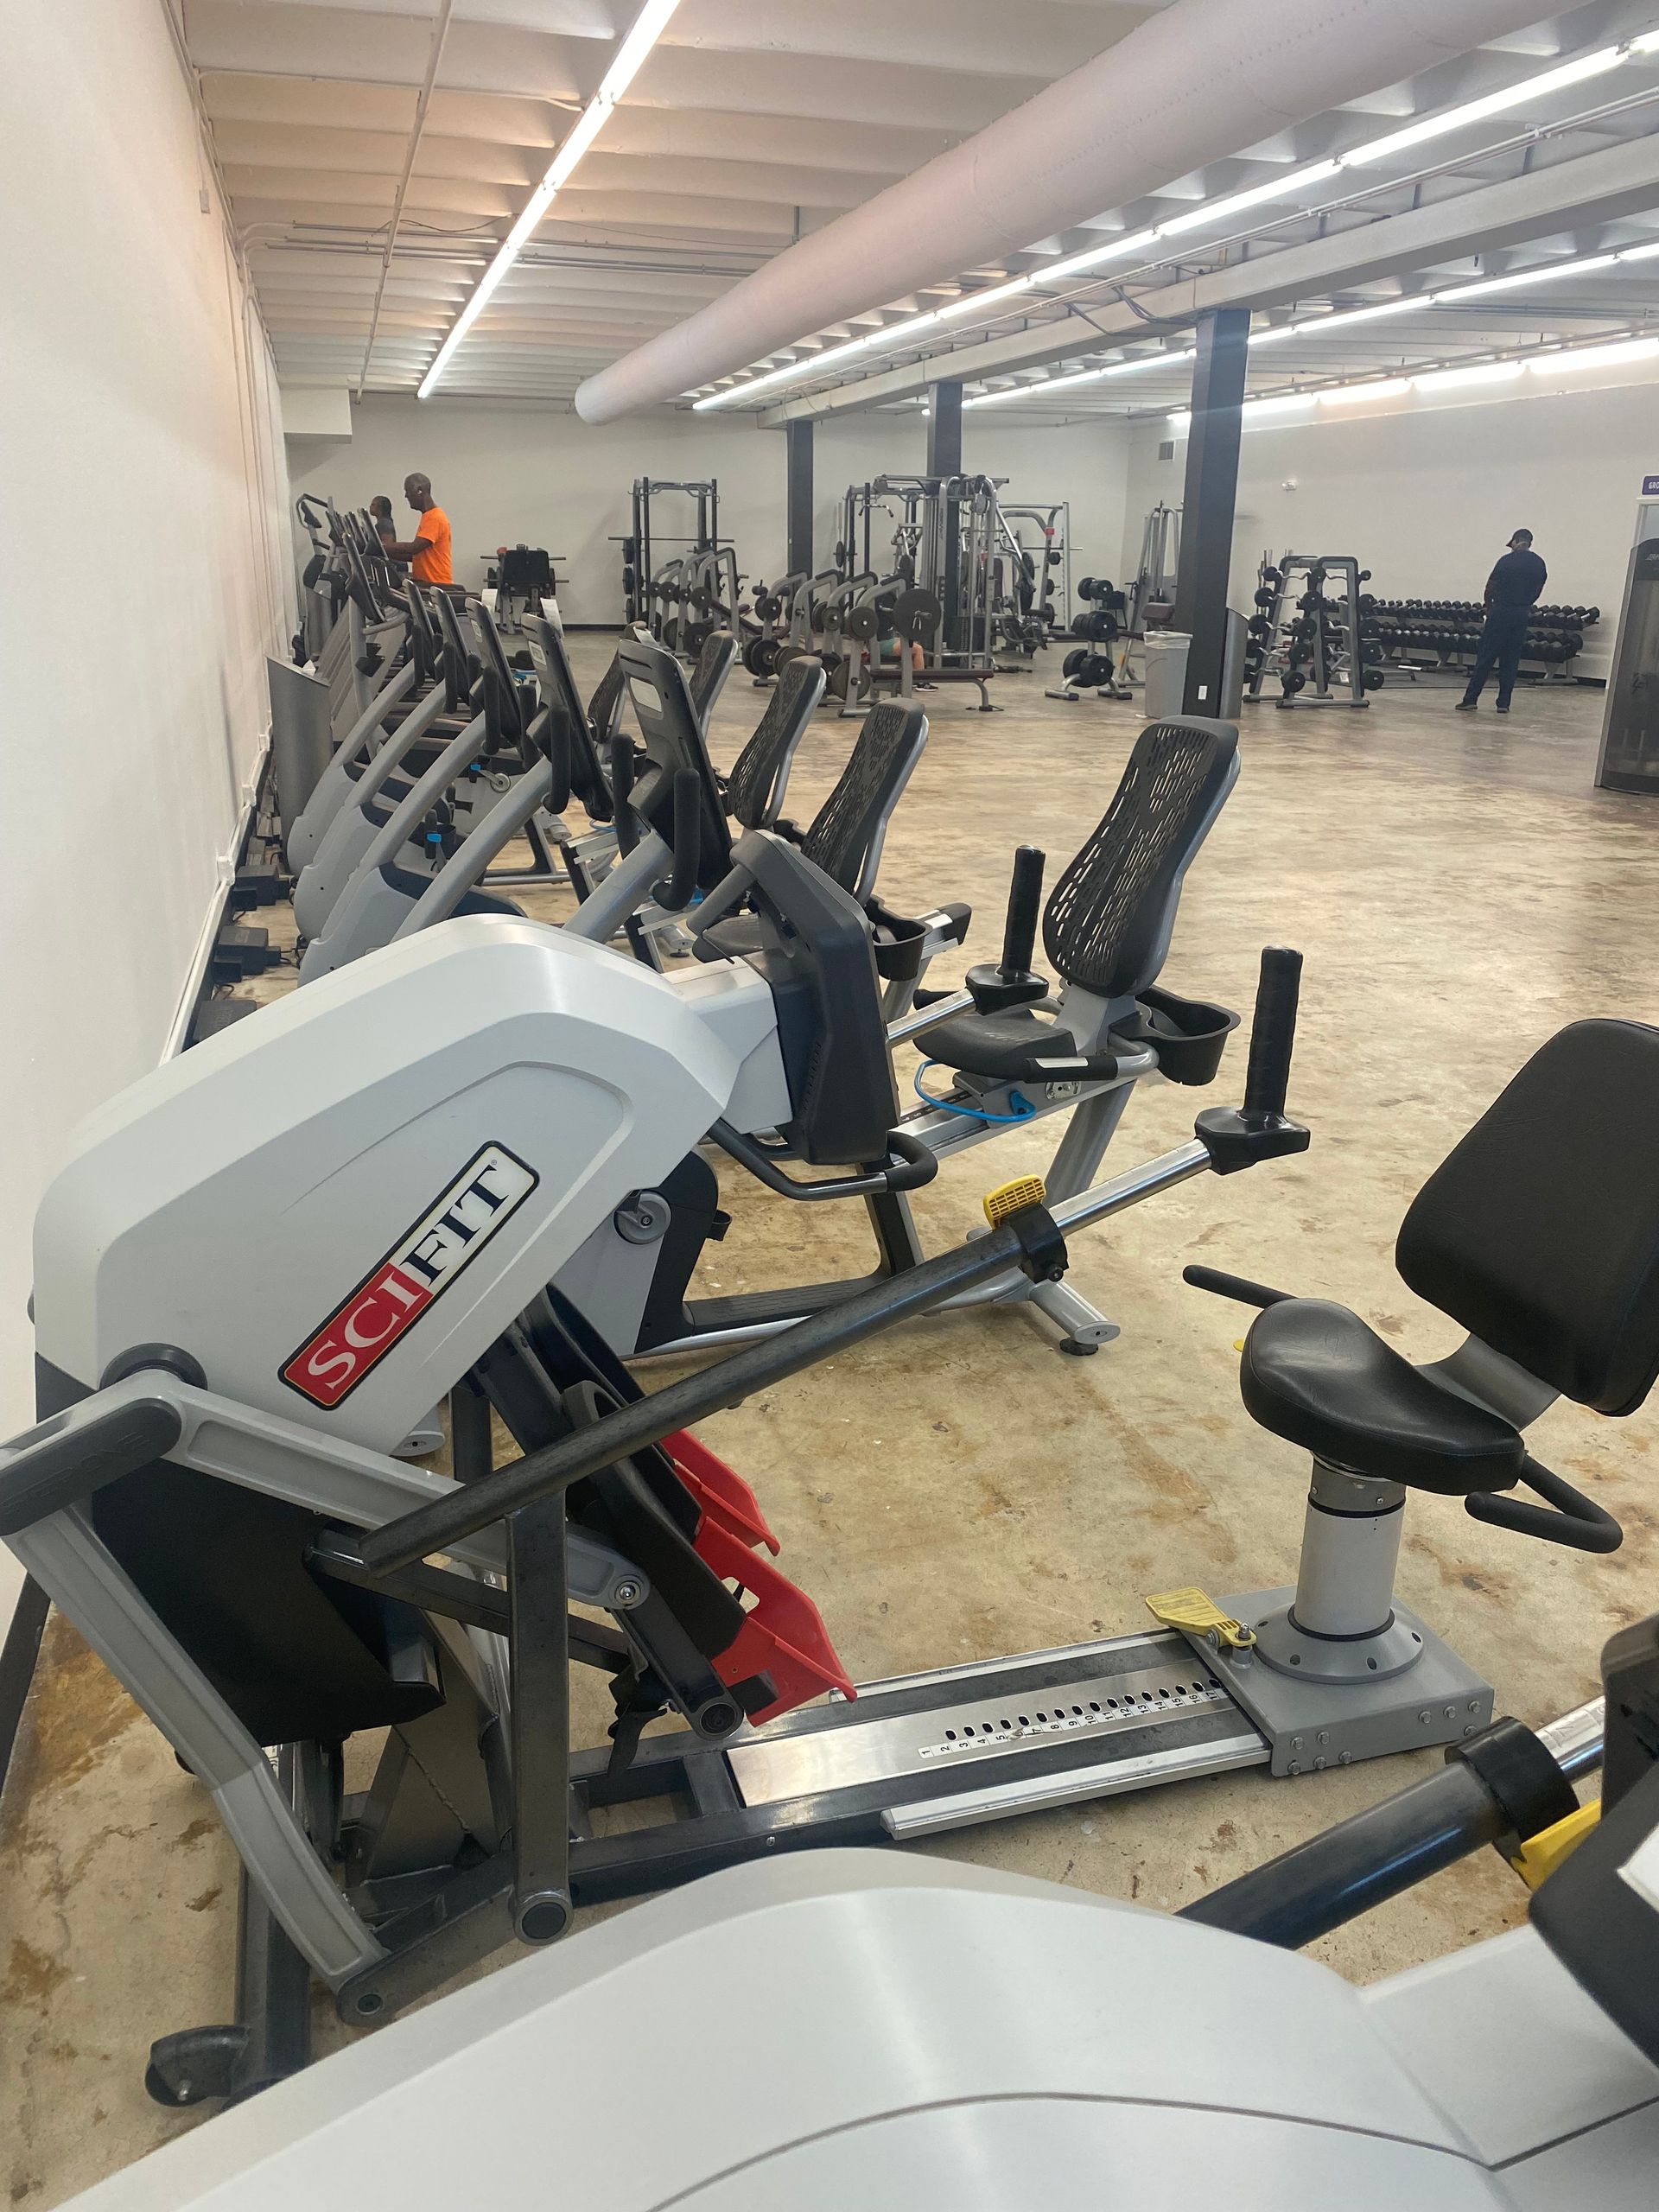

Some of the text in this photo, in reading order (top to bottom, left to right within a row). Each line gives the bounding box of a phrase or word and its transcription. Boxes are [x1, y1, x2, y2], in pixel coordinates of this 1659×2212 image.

[308, 1165, 509, 1390] SCIFIT
[1084, 1715, 1096, 1725] 10
[1103, 1712, 1113, 1720] 11
[1120, 1707, 1131, 1717] 12
[1137, 1704, 1148, 1713] 13
[1154, 1701, 1166, 1710] 14
[1172, 1698, 1183, 1707] 15
[1189, 1694, 1200, 1704] 16
